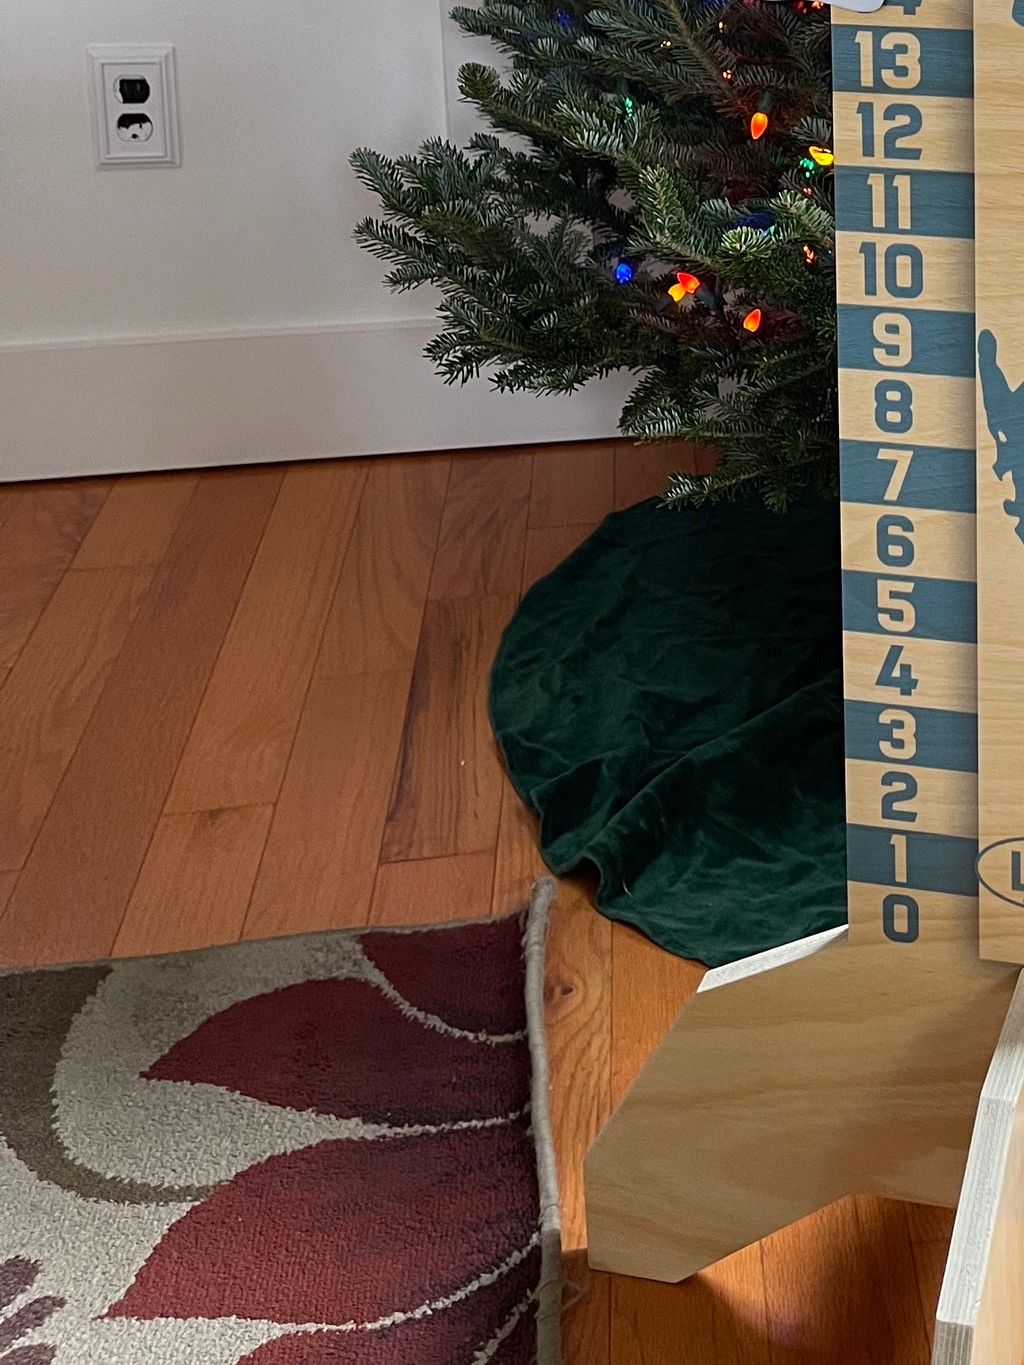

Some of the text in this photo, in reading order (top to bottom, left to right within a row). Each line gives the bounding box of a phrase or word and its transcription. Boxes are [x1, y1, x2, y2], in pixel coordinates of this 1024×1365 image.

[855, 31, 921, 89] 13
[857, 102, 923, 160] 12
[867, 174, 911, 229] 11
[859, 242, 923, 298] 10
[873, 313, 912, 367] 9
[874, 380, 913, 433] 8
[876, 449, 914, 501] 7
[877, 514, 914, 567] 6
[877, 580, 915, 632] 5
[875, 645, 918, 696] 4
[879, 708, 916, 760] 3
[881, 772, 918, 822] 2
[889, 835, 907, 883] 1
[883, 894, 919, 943] 0
